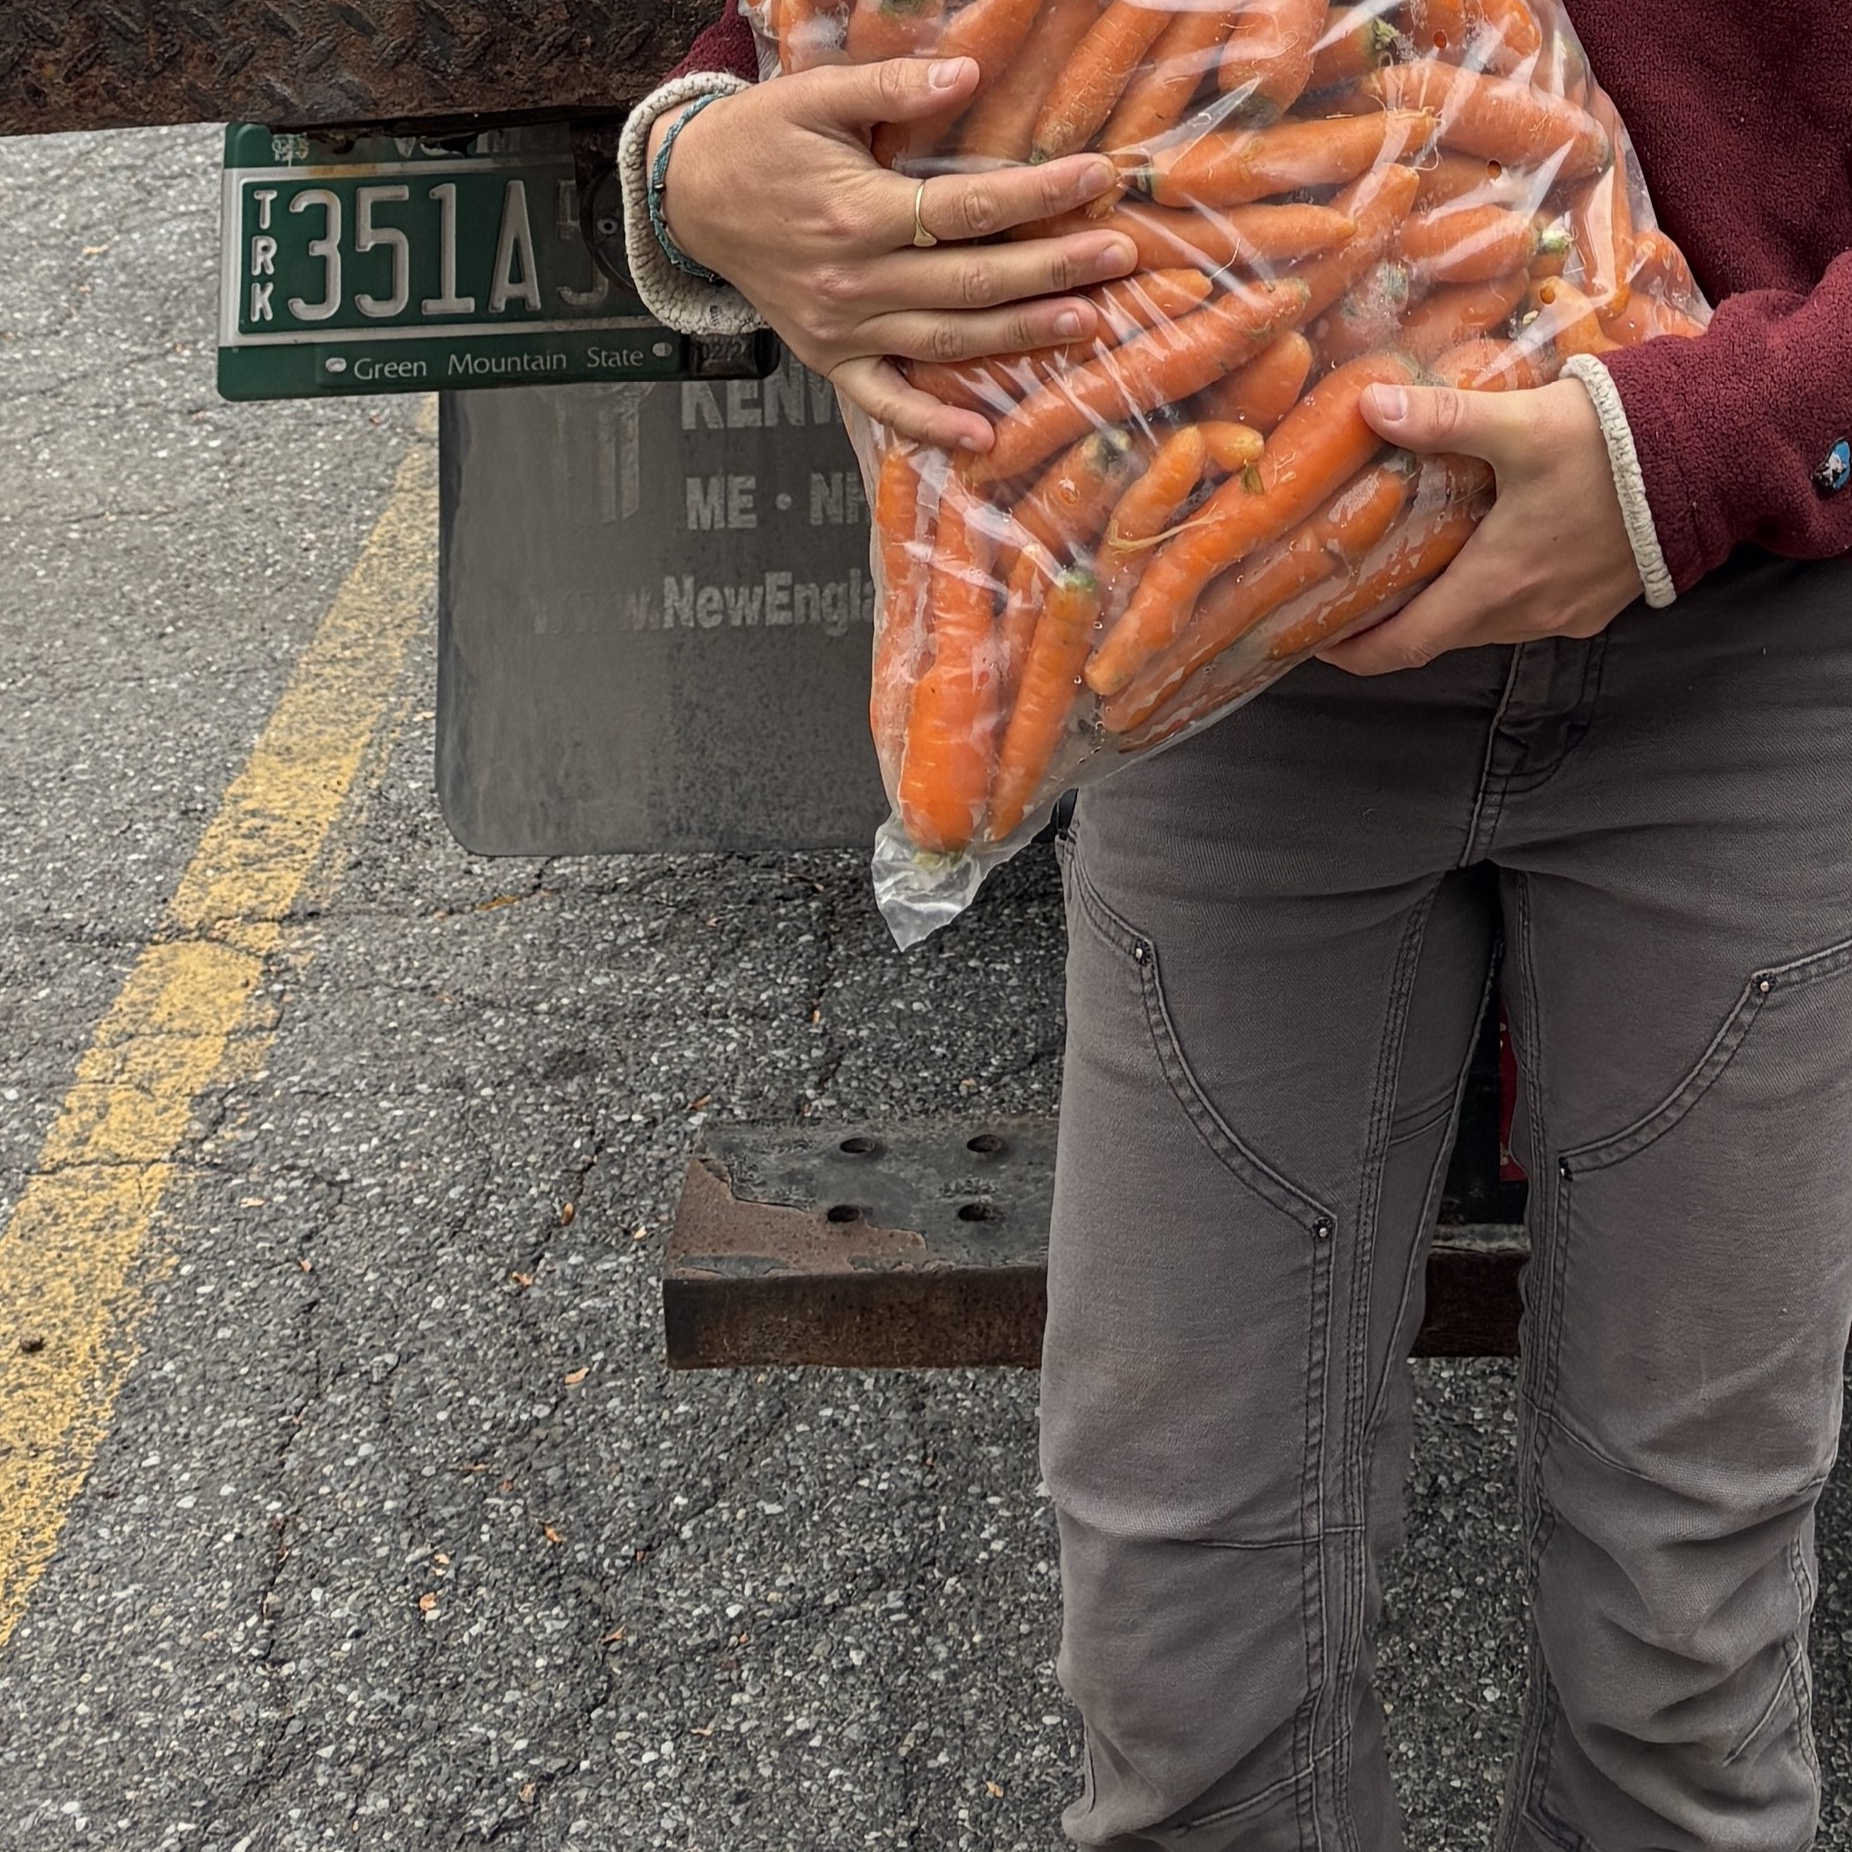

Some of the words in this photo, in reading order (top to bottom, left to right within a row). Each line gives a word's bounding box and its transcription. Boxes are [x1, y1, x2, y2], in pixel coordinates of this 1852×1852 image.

[353, 358, 427, 381] Green
[447, 350, 568, 375] Mountain
[585, 347, 644, 368] State
[686, 476, 757, 530] ME
